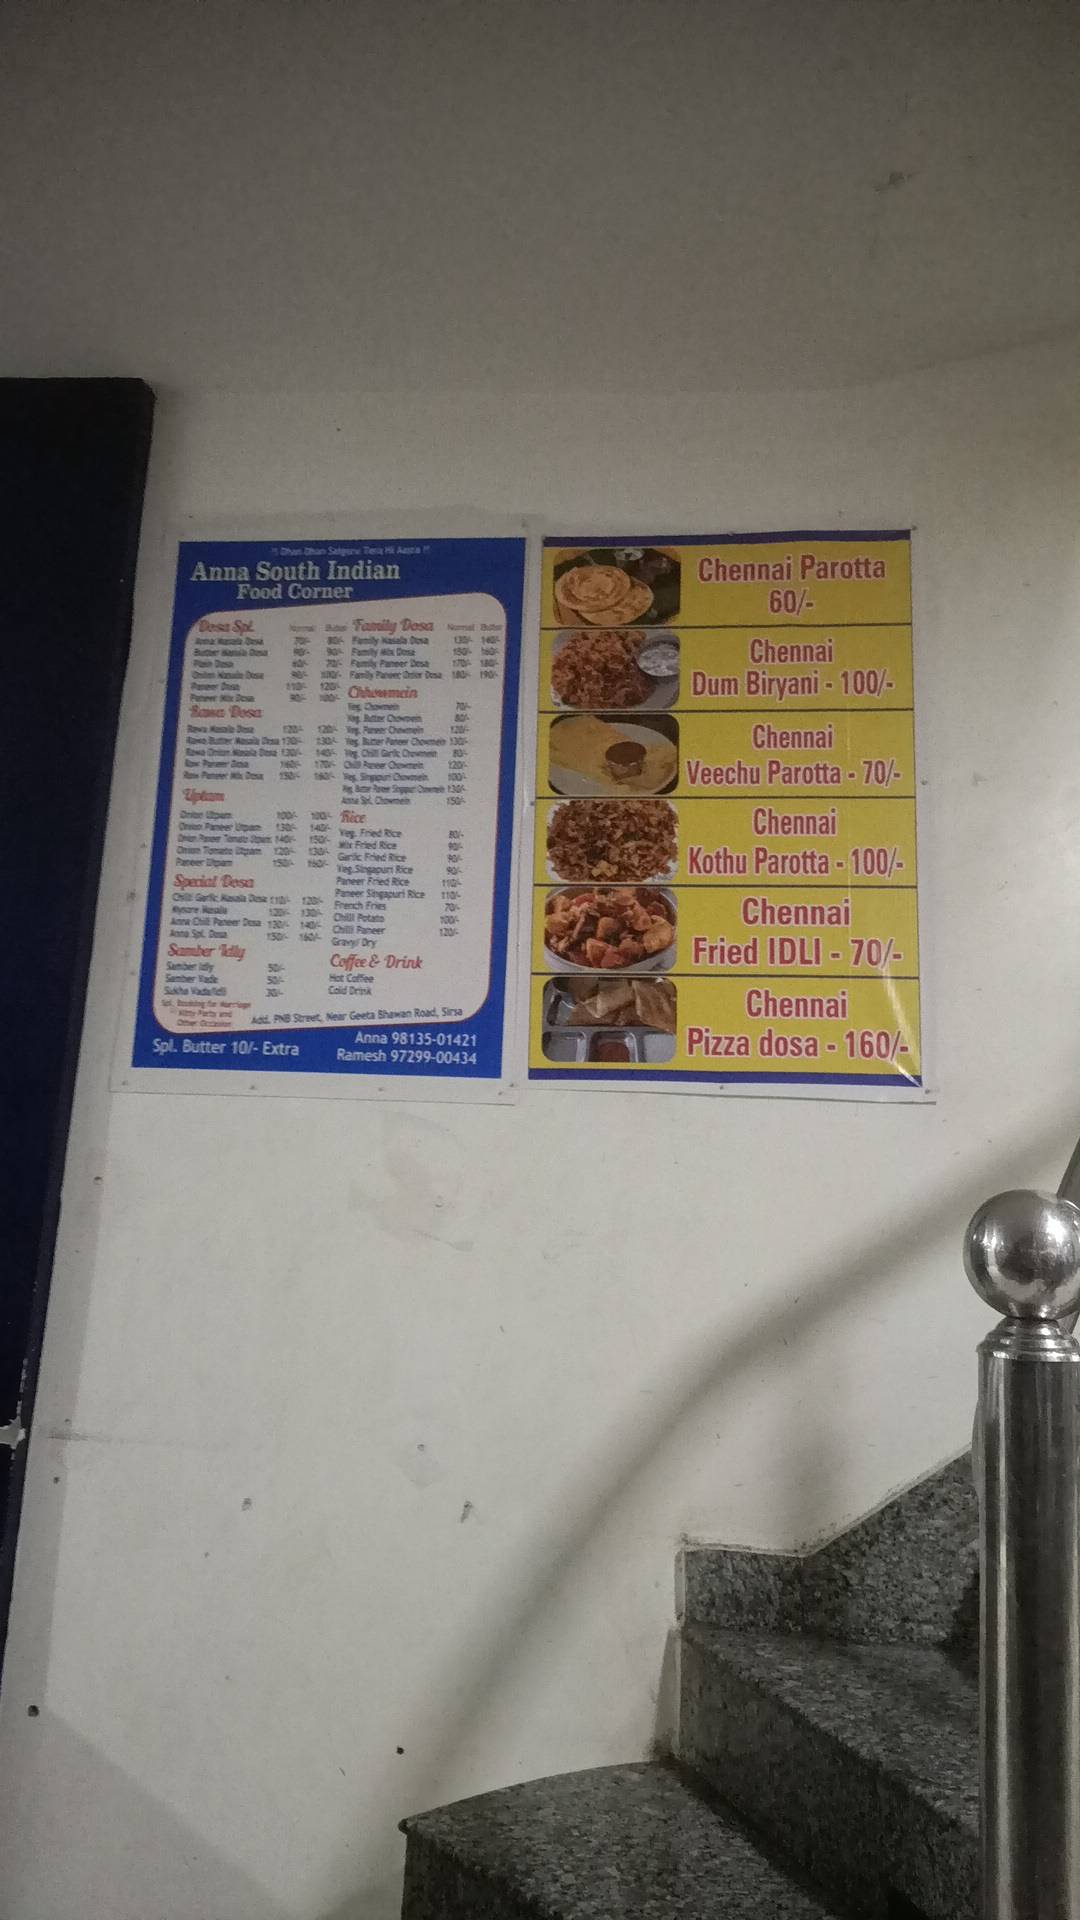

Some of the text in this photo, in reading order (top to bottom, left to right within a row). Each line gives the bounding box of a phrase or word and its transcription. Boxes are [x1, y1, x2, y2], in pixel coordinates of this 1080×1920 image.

[191, 560, 400, 581] Anna South Indian
[699, 555, 886, 582] Chennai Parotta
[236, 583, 353, 599] Food Corner
[769, 589, 814, 615] 60/-
[199, 620, 230, 632] Dosa
[353, 619, 396, 634] Family
[400, 618, 434, 632] Dosa
[749, 639, 834, 664] Chennai
[692, 671, 738, 696] Dum
[746, 669, 819, 700] Biryani
[841, 669, 894, 697] 100/-
[229, 705, 261, 717] Dosa
[752, 725, 833, 750] Chennai
[686, 760, 760, 785] Veechu
[768, 760, 841, 785] Parotta
[862, 760, 901, 786] 70/-
[340, 810, 366, 823] Rice
[753, 808, 837, 835] Chennai
[360, 829, 382, 837] Fried
[385, 829, 401, 838] Rice
[355, 841, 377, 849] Fried
[338, 853, 362, 861] Garlic
[365, 853, 386, 861] Fried
[389, 853, 406, 862] Rice
[688, 847, 747, 875] Kothu
[754, 847, 830, 874] Parotta
[851, 847, 904, 876] 100/-
[396, 866, 413, 874] Rice
[174, 874, 254, 890] Special Dosa
[336, 877, 365, 885] Paneer
[367, 877, 388, 886] Fried
[392, 877, 410, 886] Rice
[335, 889, 364, 898] Paneer
[408, 890, 425, 898] Rice
[334, 901, 460, 912] French Fries 70/-
[742, 899, 851, 926] Chennai
[358, 914, 384, 923] Potato
[357, 926, 459, 936] Paneer 120/-
[362, 938, 376, 948] Dry
[693, 937, 760, 965] Fried
[768, 937, 822, 965] IDLI
[851, 939, 903, 967] 70/-
[330, 954, 423, 971] Coffee & Drink
[329, 974, 374, 983] Hot Coffee
[328, 986, 371, 995] Cold Drink
[746, 990, 848, 1018] Chennai
[274, 1015, 290, 1023] PNB
[327, 1013, 346, 1021] Near
[350, 1012, 375, 1020] Geeta
[378, 1009, 412, 1019] Bhawan
[415, 1008, 439, 1017] Road,
[442, 1007, 462, 1016] Sirsa
[153, 1038, 299, 1056] Spl. Butter 10/- Extra
[355, 1032, 476, 1046] Anna 98135-01421
[687, 1029, 750, 1057] Pizza
[760, 1030, 818, 1058] dosa
[845, 1030, 909, 1059] 160/-
[337, 1049, 477, 1064] Ramesh 97299-00434
